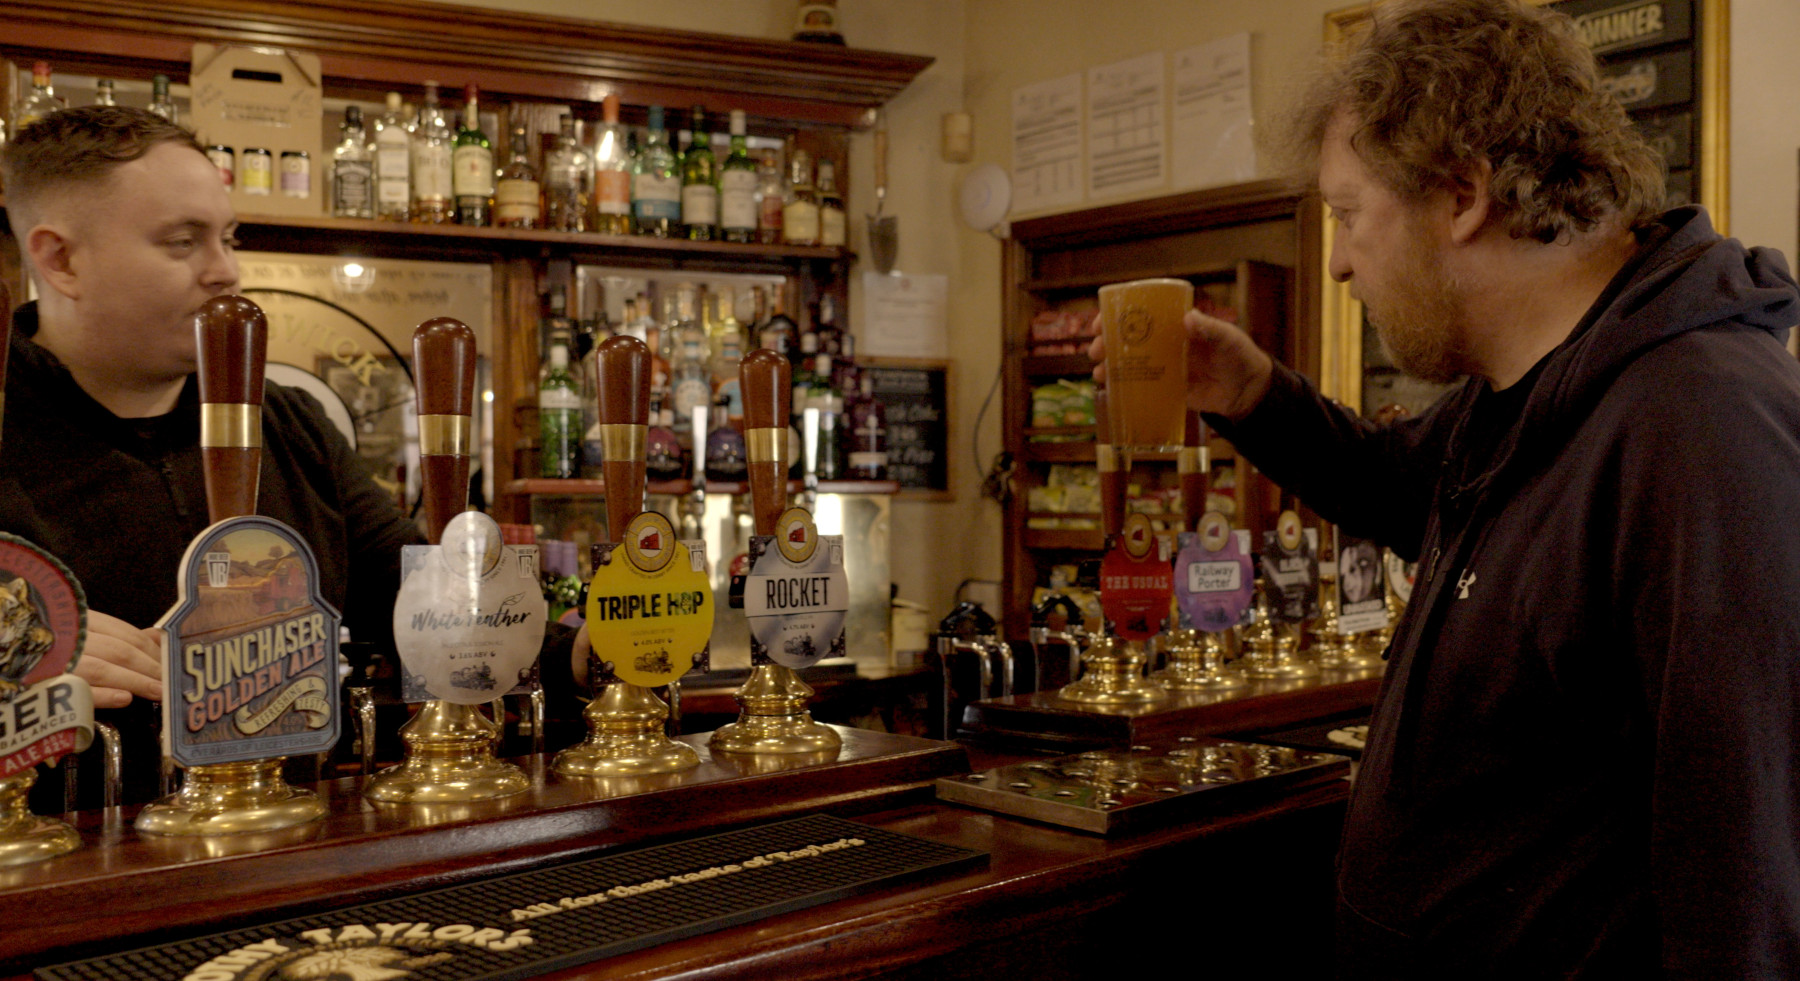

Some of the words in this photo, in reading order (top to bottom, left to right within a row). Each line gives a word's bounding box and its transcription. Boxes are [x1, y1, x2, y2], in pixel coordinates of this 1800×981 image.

[1106, 575, 1129, 589] THE
[1132, 575, 1168, 589] USUAL
[1194, 564, 1235, 577] Railway
[1198, 577, 1231, 589] Porter
[597, 593, 661, 621] TRIPLE
[667, 590, 704, 616] HOP
[766, 576, 830, 609] ROCKET
[411, 608, 464, 632] White
[182, 612, 327, 703] SUNCHASER
[187, 662, 283, 732] GOLDEN
[287, 640, 326, 678] ALE
[0, 683, 74, 739] ER
[254, 684, 302, 729] REFRESHING
[0, 713, 77, 750] BALANCED
[4, 745, 42, 774] ALE
[510, 902, 562, 923] All
[559, 892, 608, 910] for
[607, 878, 674, 899] that
[669, 863, 743, 885] taste
[742, 855, 774, 870] of
